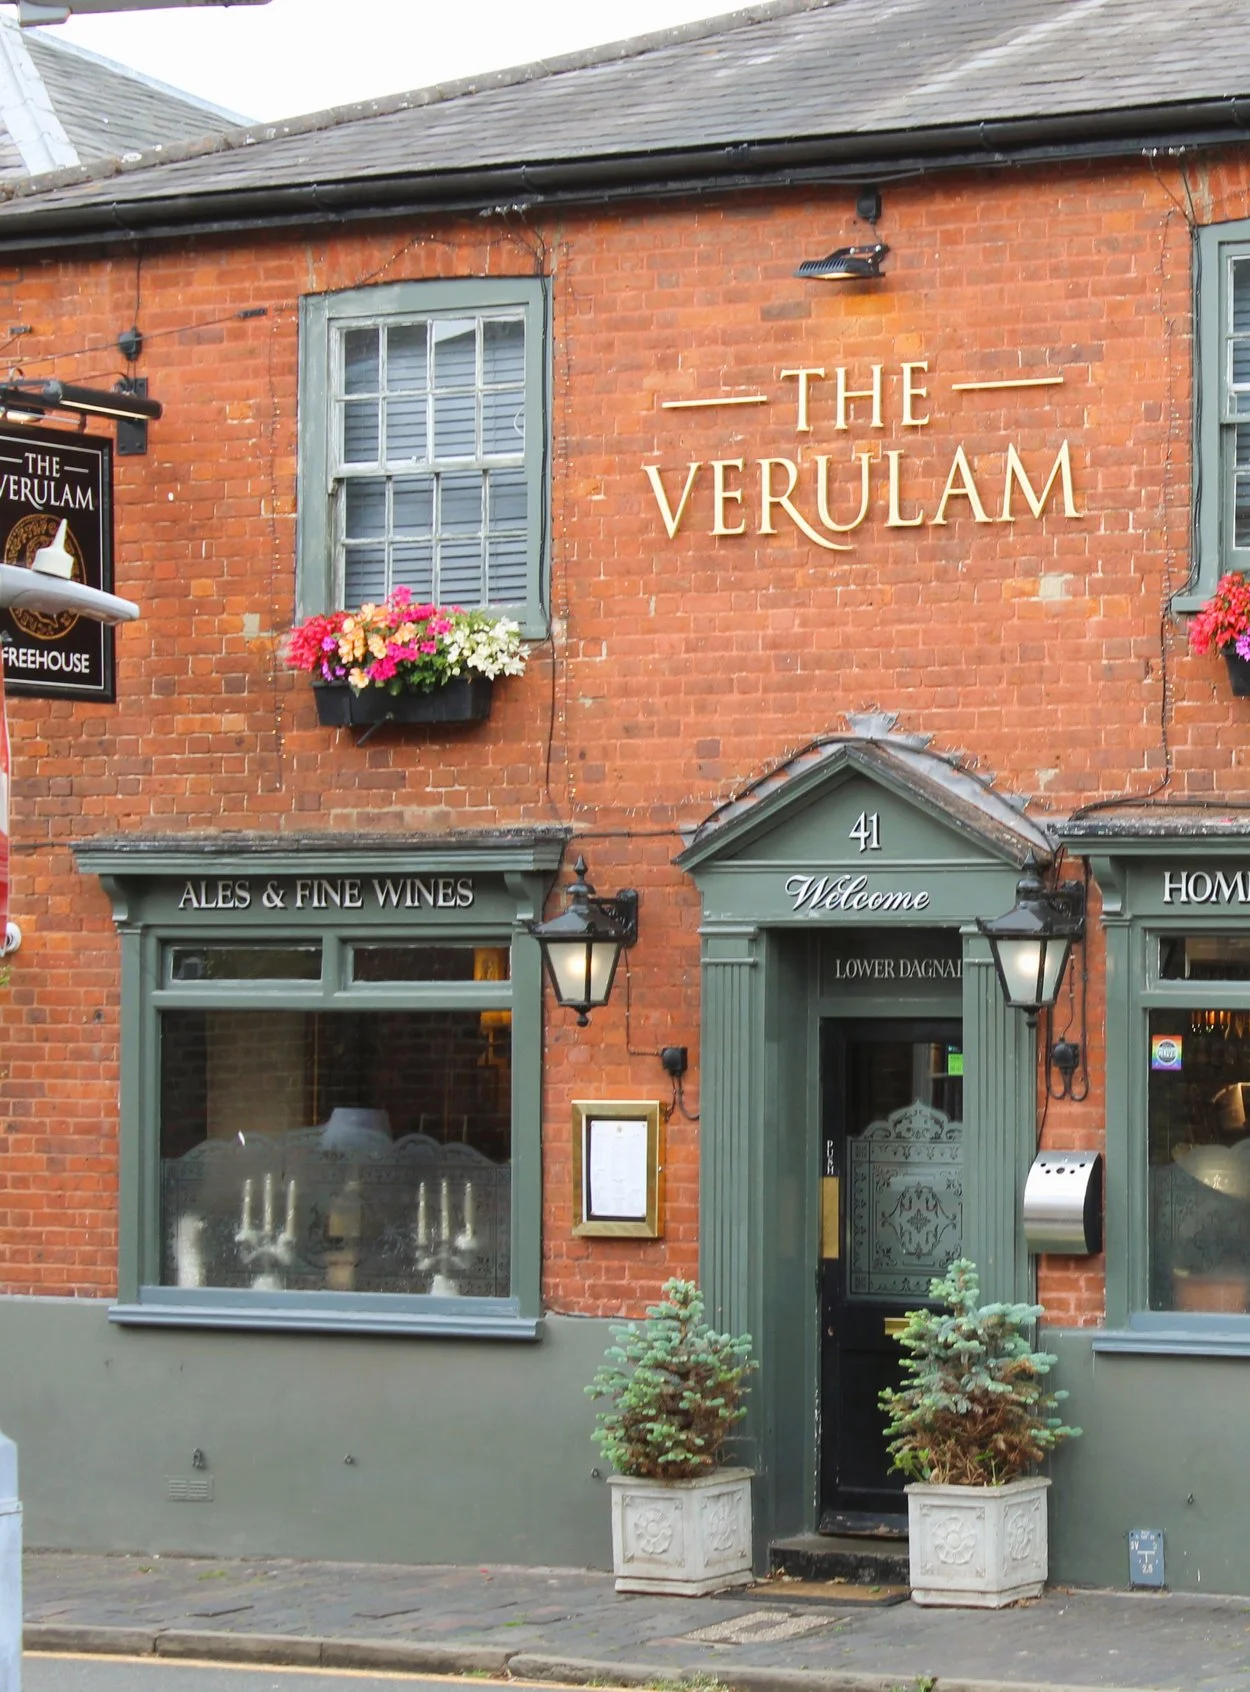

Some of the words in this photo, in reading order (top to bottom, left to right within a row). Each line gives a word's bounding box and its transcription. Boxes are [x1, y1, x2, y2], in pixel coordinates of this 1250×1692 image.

[780, 360, 930, 432] THE
[24, 452, 61, 478] THE
[640, 439, 1085, 552] VERULAM
[2, 646, 91, 674] FREEHOUSE
[849, 810, 882, 852] 41
[178, 880, 252, 910] ALES
[262, 881, 286, 909] &
[295, 879, 363, 909] FINE
[372, 878, 475, 908] WINES
[785, 874, 931, 911] Welcome
[835, 958, 895, 978] LOWER
[826, 1140, 840, 1175] PUSH
